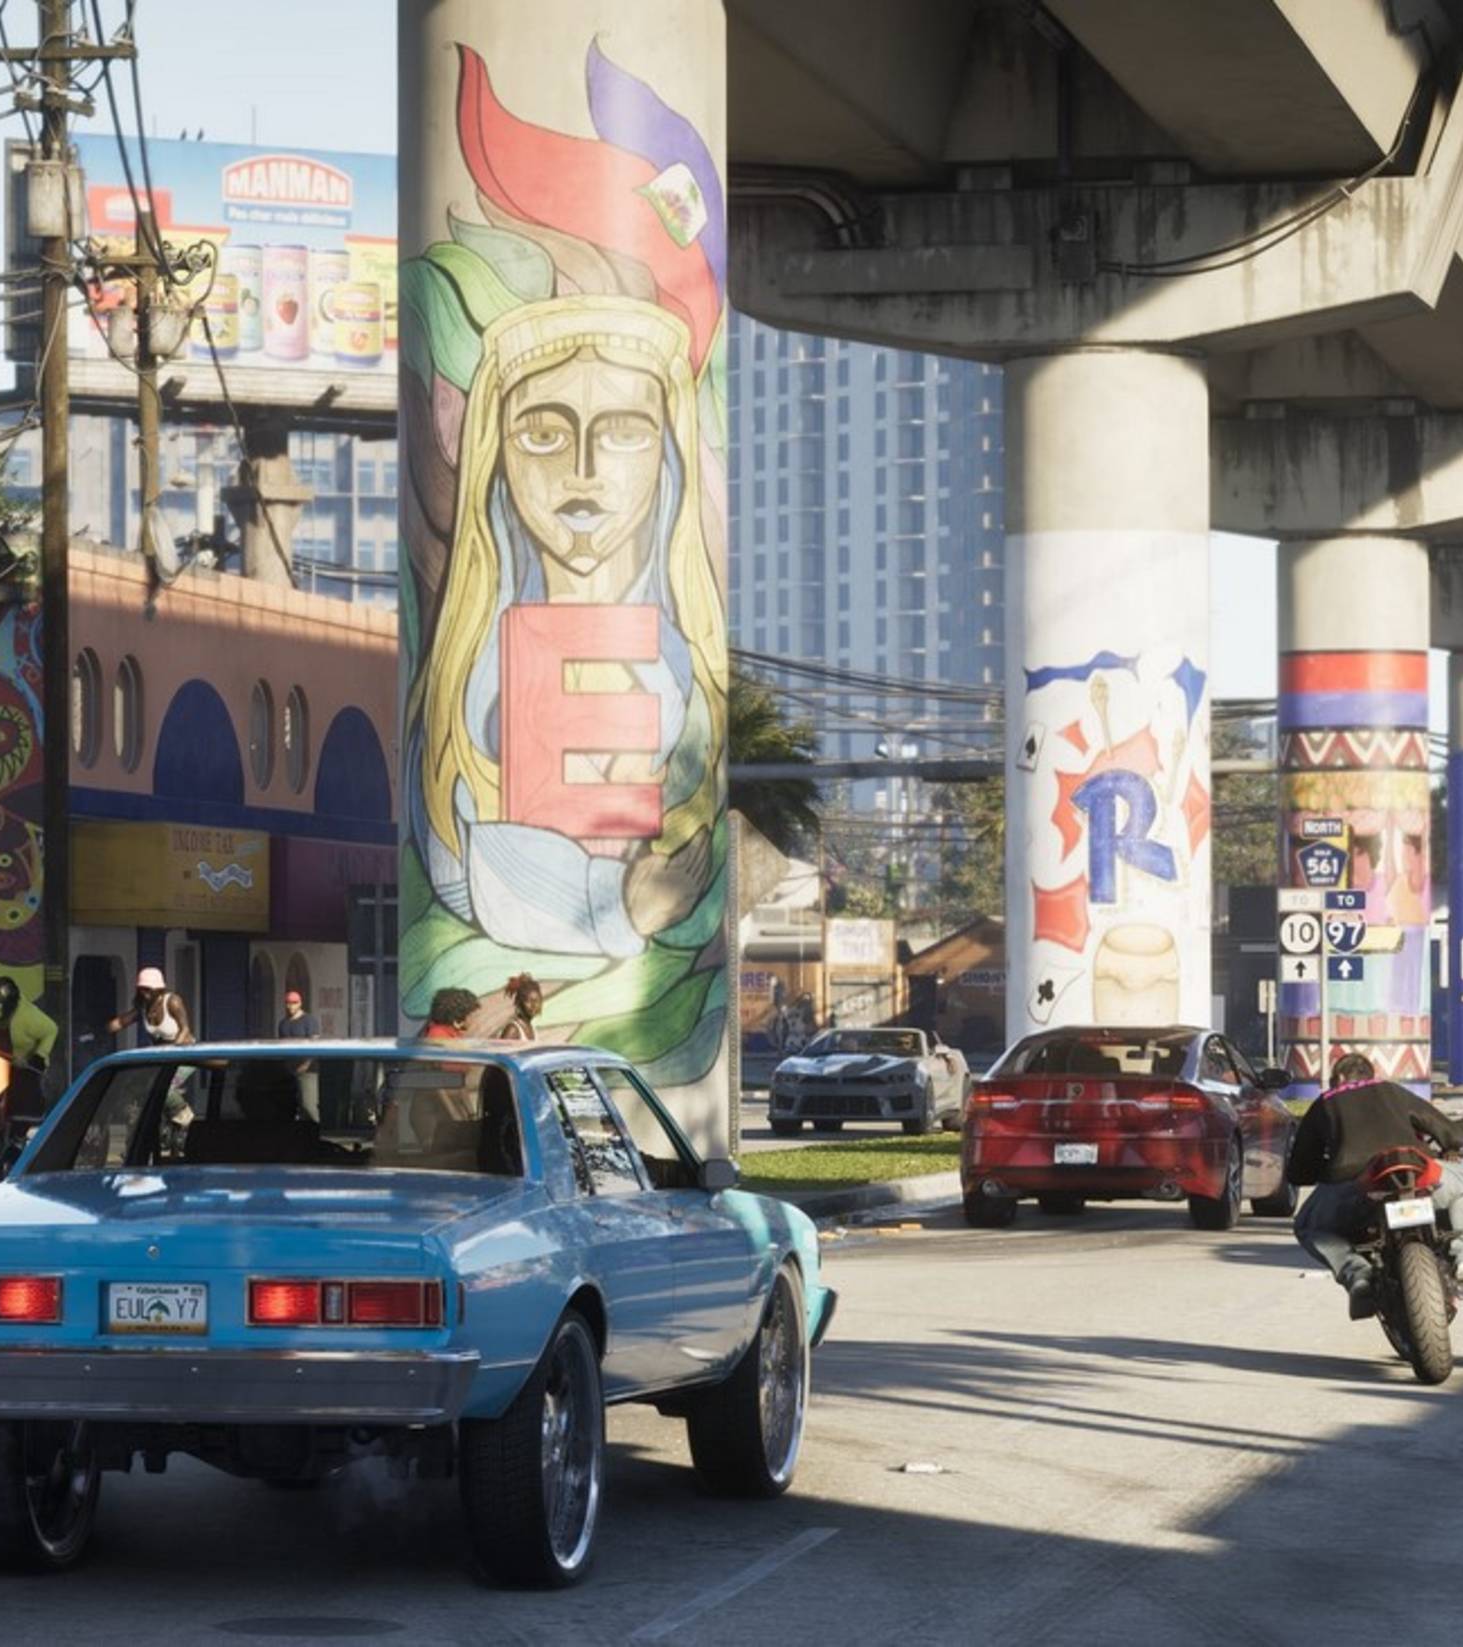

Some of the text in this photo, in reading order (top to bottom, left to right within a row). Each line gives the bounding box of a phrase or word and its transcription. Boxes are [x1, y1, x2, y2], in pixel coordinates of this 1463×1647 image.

[229, 162, 347, 202] MANMAN
[499, 604, 663, 839] E
[1069, 768, 1178, 905] R
[1303, 821, 1342, 834] NORTH
[1306, 859, 1339, 875] 561
[1336, 895, 1355, 906] TO
[1288, 924, 1314, 943] 10
[1328, 922, 1362, 946] 97
